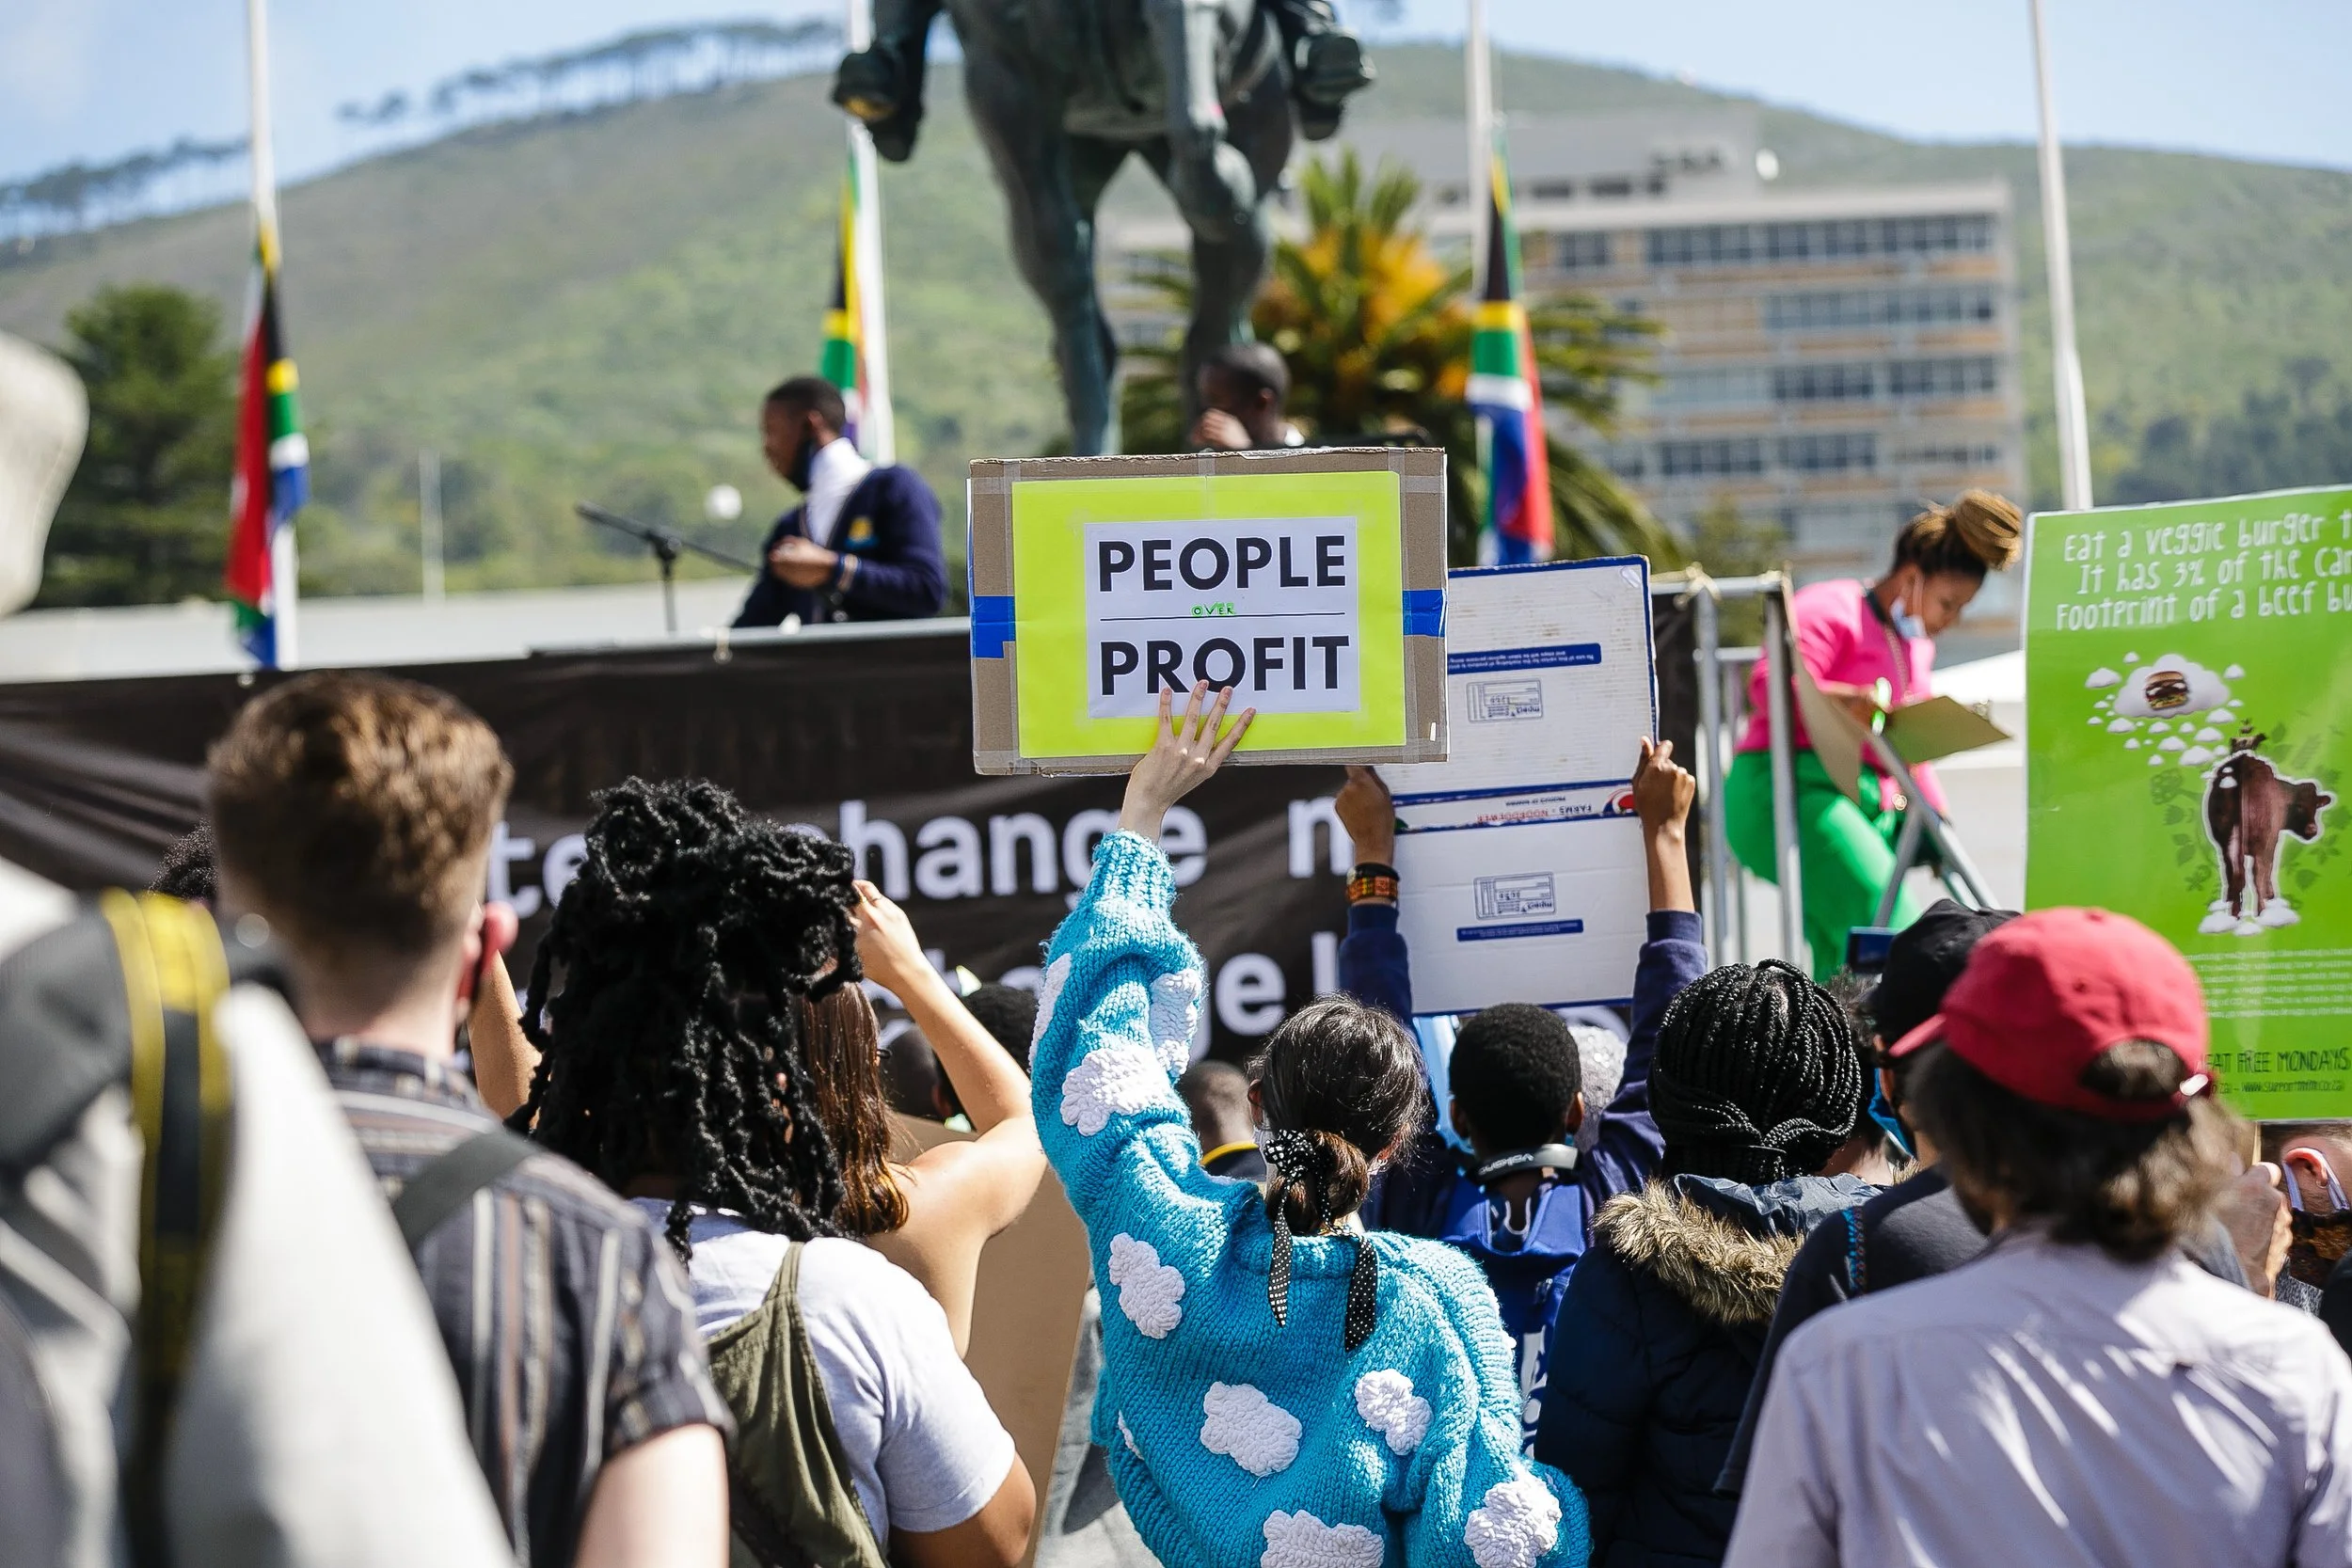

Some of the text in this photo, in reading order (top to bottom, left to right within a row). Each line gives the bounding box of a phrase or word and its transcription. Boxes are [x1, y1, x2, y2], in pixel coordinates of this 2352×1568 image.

[2064, 531, 2107, 562] Eat
[2117, 531, 2133, 559] a
[2146, 522, 2226, 555] veggie
[2237, 513, 2326, 547] burger
[1099, 535, 1345, 592] PEOPLE
[2076, 564, 2106, 594] It
[2116, 561, 2162, 593] has
[2173, 558, 2205, 588] 3%
[2217, 550, 2250, 585] of
[2259, 549, 2302, 580] the
[1191, 602, 1235, 617] OVER
[2189, 587, 2222, 622] of
[2230, 589, 2246, 619] a
[2258, 580, 2318, 617] beef
[1101, 636, 1349, 696] PROFIT
[787, 800, 1209, 909] hange
[2237, 1050, 2271, 1073] FREE
[2277, 1047, 2352, 1072] MONDAYS
